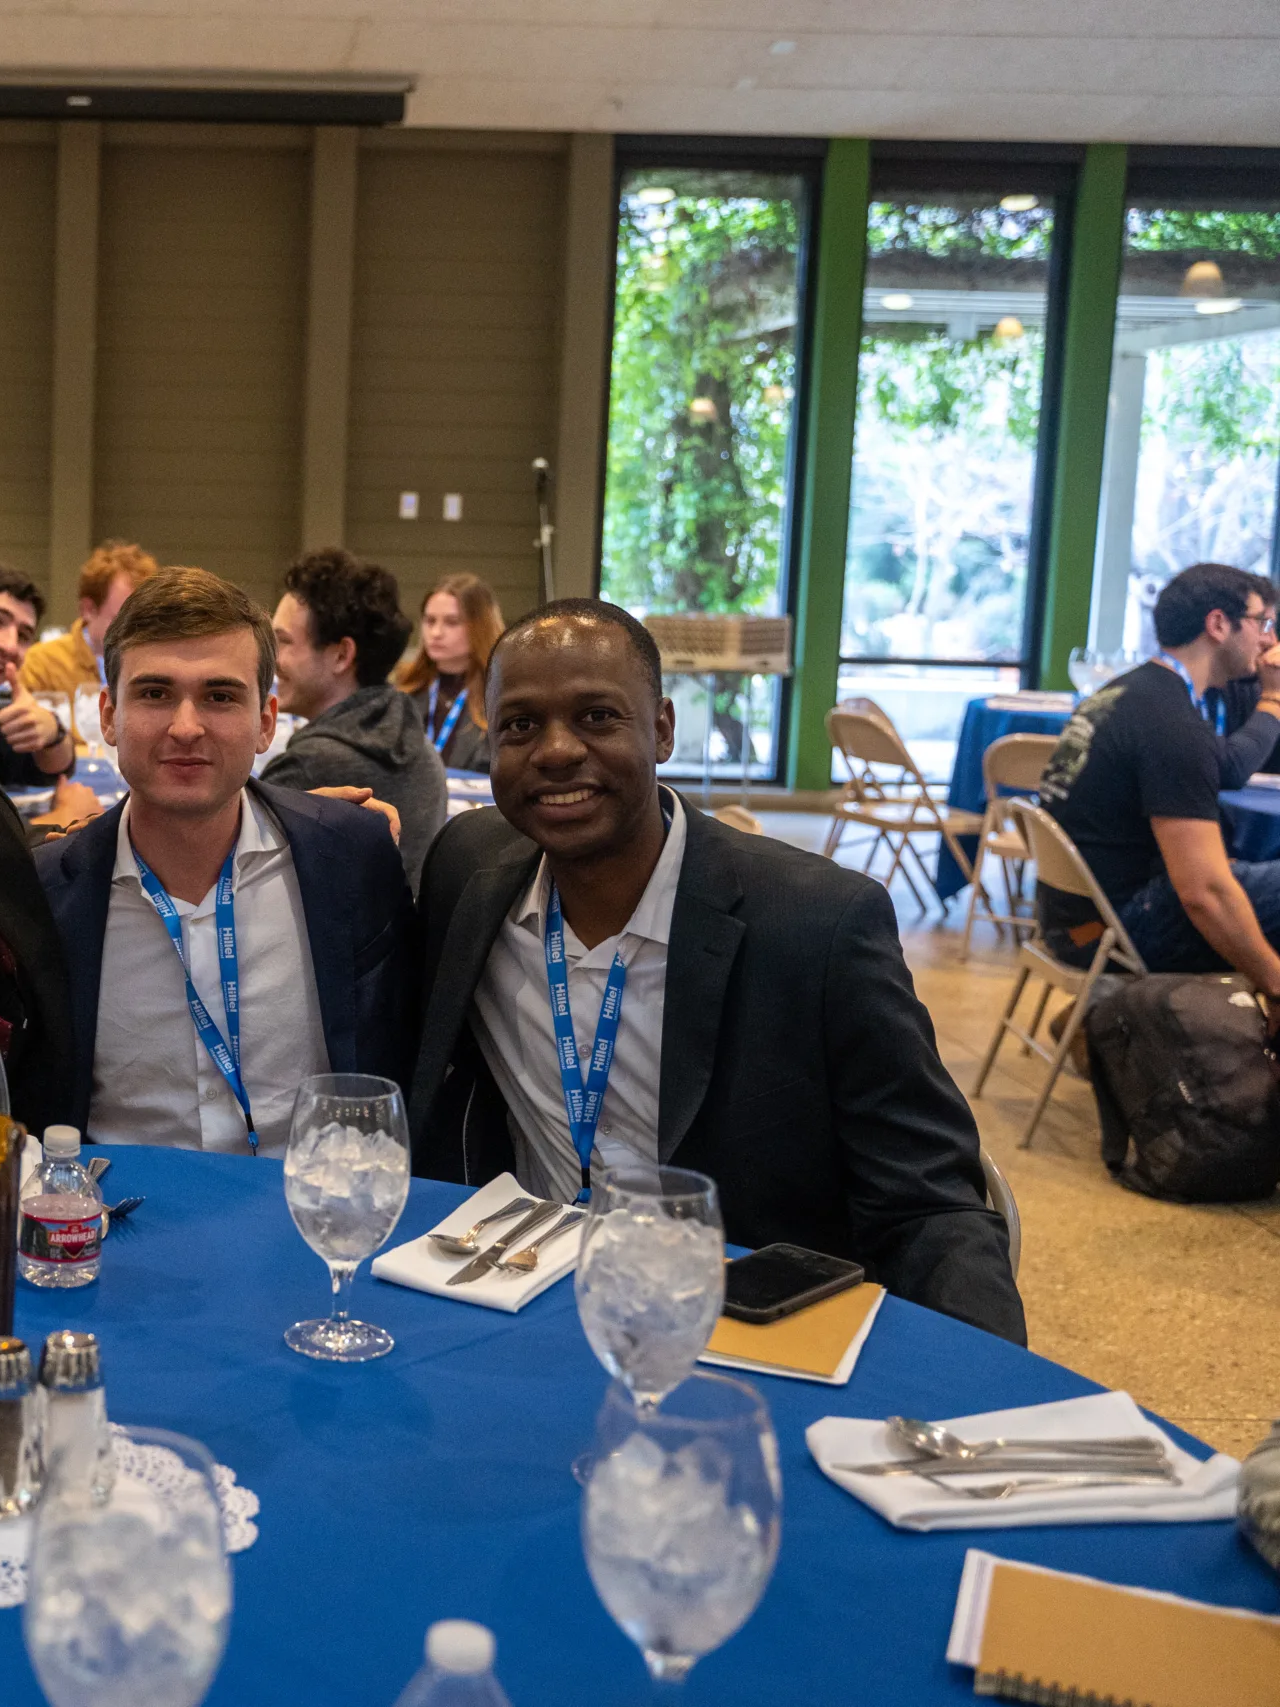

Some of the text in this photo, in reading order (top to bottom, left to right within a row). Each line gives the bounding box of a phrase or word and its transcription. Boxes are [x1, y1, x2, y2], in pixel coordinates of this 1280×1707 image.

[152, 893, 173, 917] Hillel
[222, 877, 233, 905] Hillel
[223, 927, 234, 959] Hillel
[551, 931, 563, 963] Hillel
[227, 981, 237, 1013] Hillel
[555, 983, 568, 1016] Hillel
[603, 986, 618, 1020] Hillel
[191, 999, 213, 1029] Hillel
[214, 1043, 236, 1074] Hillel
[563, 1036, 577, 1069] Hillel
[592, 1038, 608, 1072] Hillel
[583, 1091, 598, 1123] Hillel
[50, 1230, 95, 1244] ARROWHEAD
